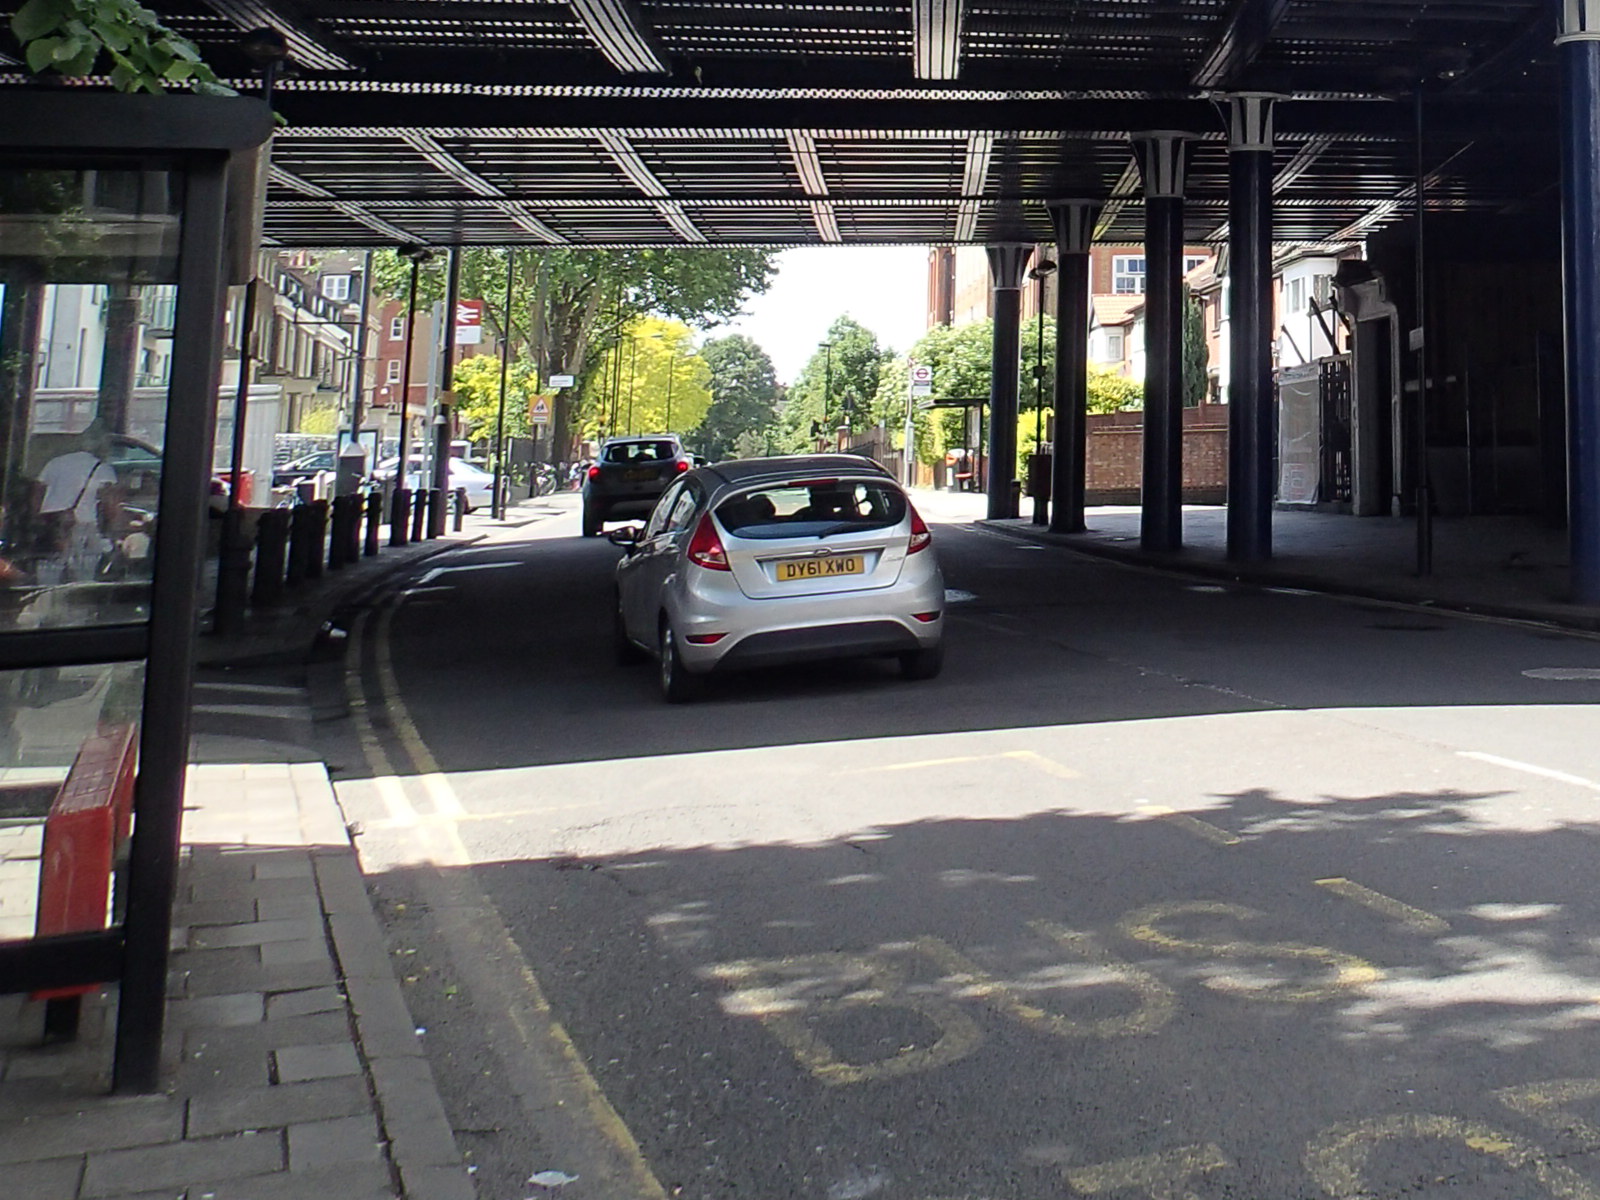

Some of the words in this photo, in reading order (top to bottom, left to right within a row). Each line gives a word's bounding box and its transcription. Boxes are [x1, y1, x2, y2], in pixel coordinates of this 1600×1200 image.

[786, 561, 822, 578] DY61
[826, 558, 856, 575] XWO
[703, 898, 1383, 1088] BUS
